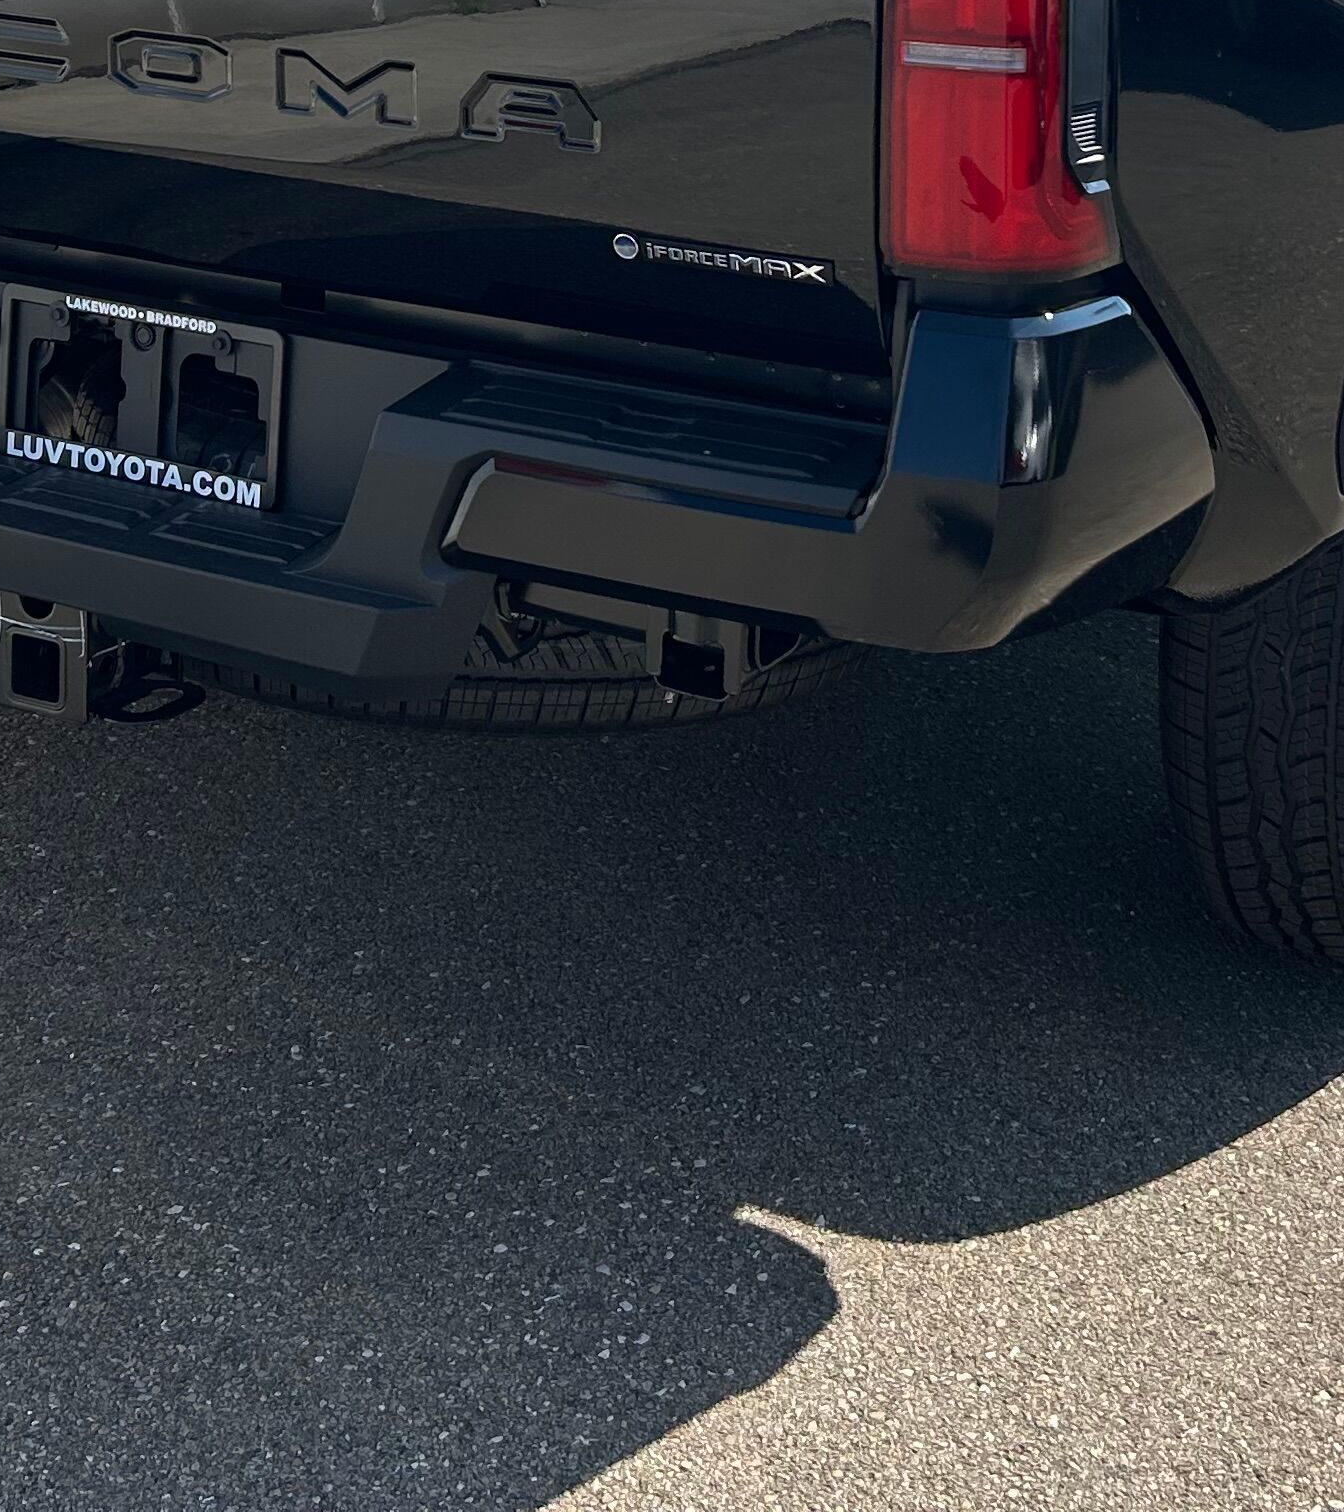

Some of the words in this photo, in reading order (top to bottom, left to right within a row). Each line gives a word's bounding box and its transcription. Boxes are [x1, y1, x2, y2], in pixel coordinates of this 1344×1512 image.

[65, 295, 138, 320] LAKEWOOD
[146, 311, 218, 335] BRADFORD
[6, 431, 261, 508] LUVTOYOTA.COM
